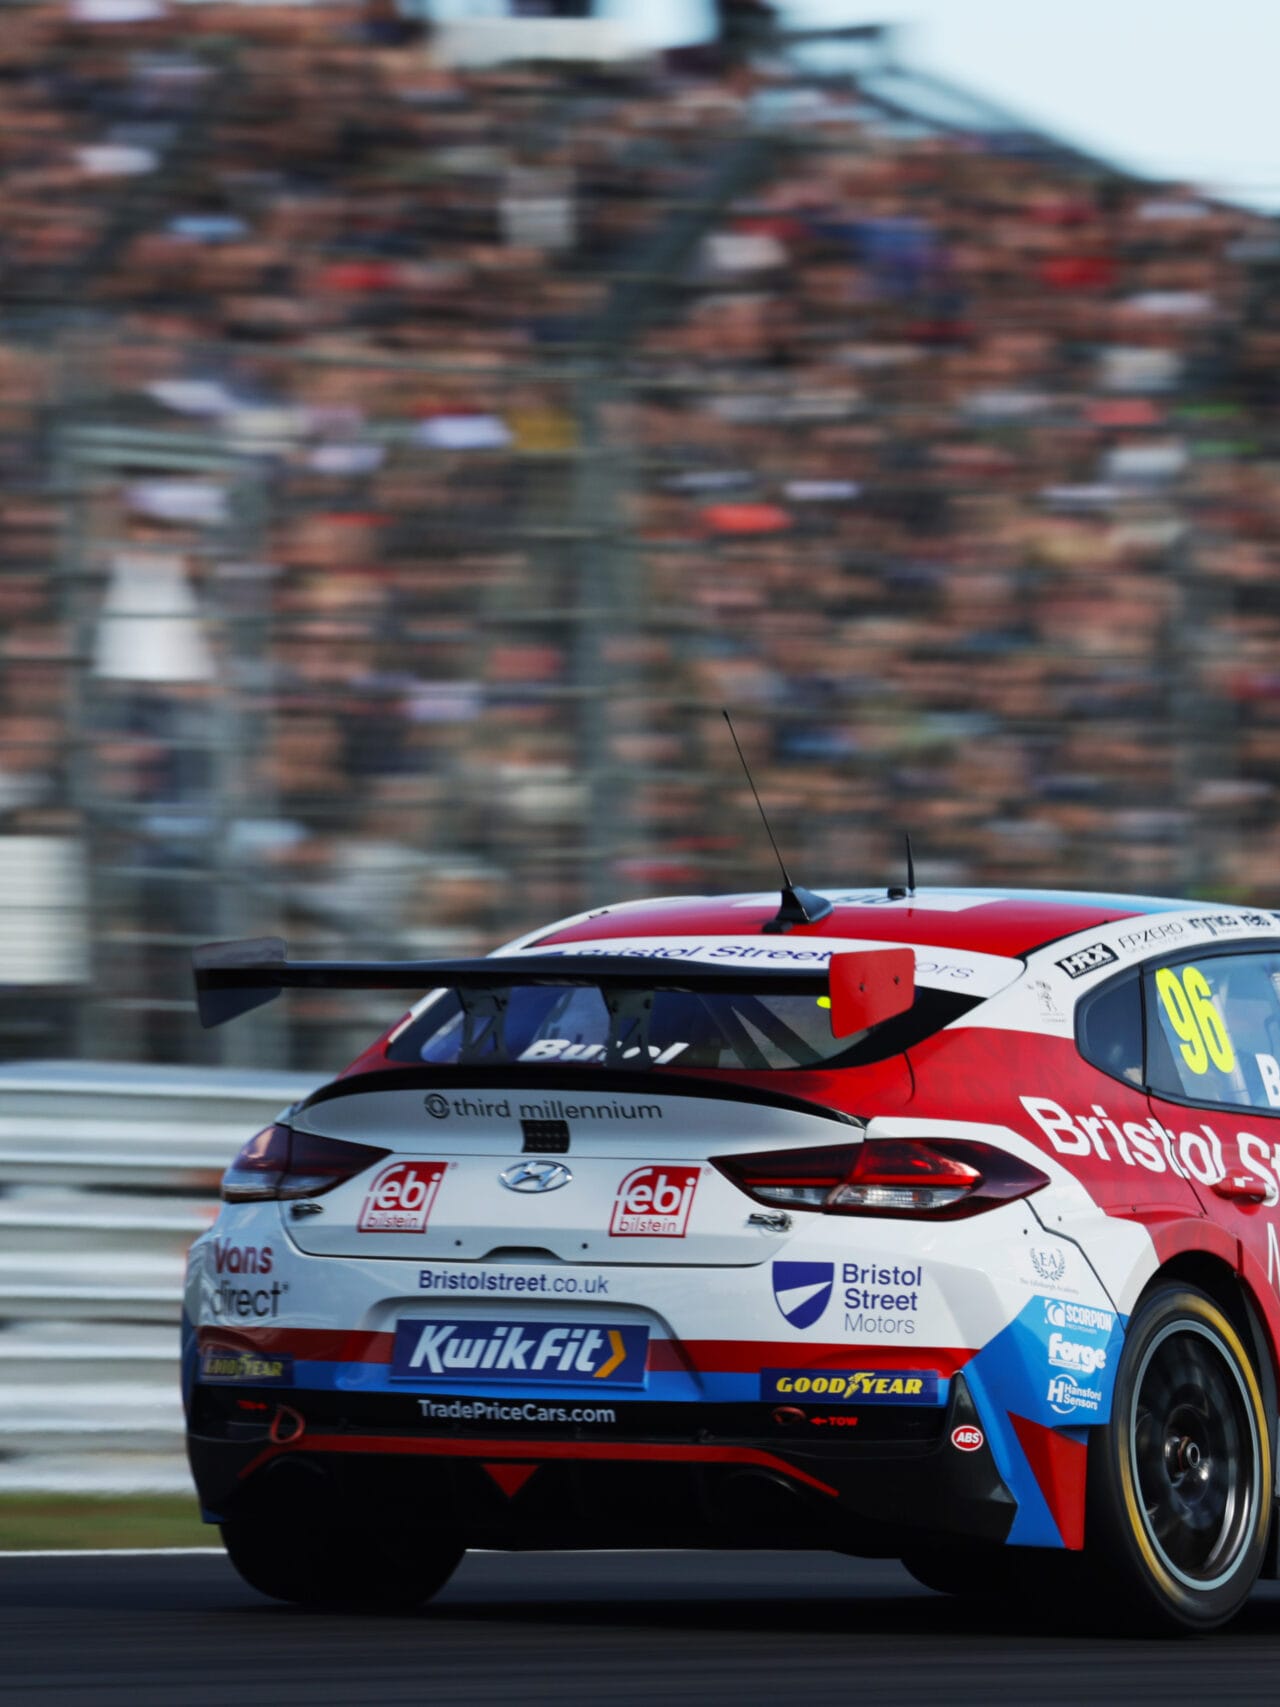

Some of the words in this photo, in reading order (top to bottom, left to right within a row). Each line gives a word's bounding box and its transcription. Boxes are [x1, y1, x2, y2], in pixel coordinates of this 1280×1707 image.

[709, 944, 834, 962] Street
[1062, 946, 1112, 974] HRX
[1155, 966, 1235, 1075] 96
[454, 1099, 511, 1118] third
[519, 1100, 663, 1119] millennium
[1019, 1095, 1228, 1187] Bristol
[364, 1164, 442, 1216] febi
[616, 1168, 698, 1222] febi
[366, 1212, 419, 1228] bilstein
[619, 1217, 678, 1233] bilstein
[212, 1238, 273, 1274] Vans
[1040, 1252, 1058, 1269] EA
[418, 1269, 609, 1294] Bristolstreet.co.uk
[842, 1263, 923, 1287] Bristol
[844, 1288, 918, 1311] Street
[844, 1313, 916, 1334] Motors
[1065, 1304, 1112, 1332] SCORPION
[1064, 1395, 1098, 1411] Sensors
[1065, 1384, 1101, 1401] Hansford
[417, 1399, 617, 1423] TradePriceCars.com
[829, 1416, 859, 1427] TOW
[956, 1431, 980, 1445] ABS
